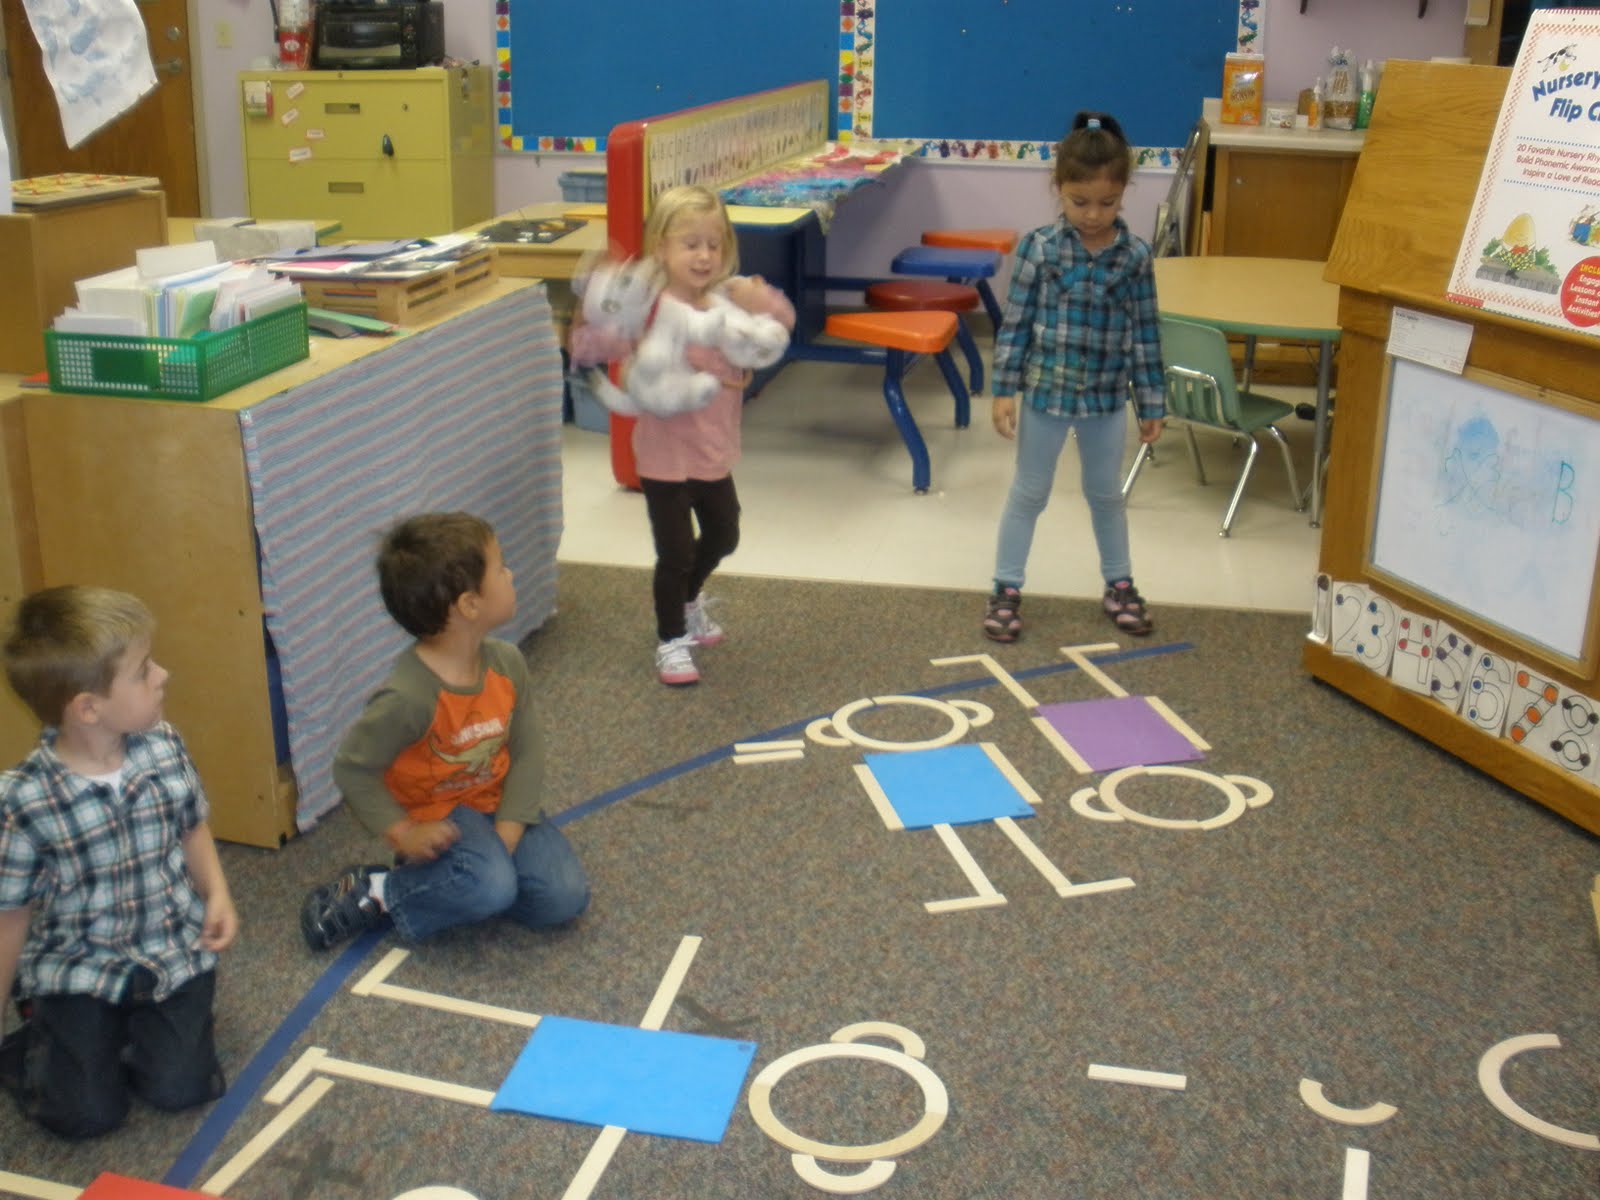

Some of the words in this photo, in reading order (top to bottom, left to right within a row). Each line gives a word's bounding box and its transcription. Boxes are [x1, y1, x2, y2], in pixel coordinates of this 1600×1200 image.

[1532, 71, 1600, 101] Nursery
[1550, 97, 1583, 122] Flip
[1517, 144, 1527, 152] 20
[1528, 145, 1555, 156] Favorite
[1557, 149, 1586, 161] Nursery
[1516, 155, 1533, 164] Build
[1535, 157, 1569, 169] Phonemic
[1523, 168, 1546, 178] Inspire
[1554, 172, 1571, 182] Love
[1572, 175, 1582, 183] of
[1570, 283, 1596, 295] Lessons
[1575, 294, 1599, 307] Instant
[1552, 461, 1575, 525] B
[1335, 584, 1367, 654] 2
[1356, 597, 1395, 670] 3
[1397, 617, 1435, 686] 4
[1431, 632, 1473, 700] 5
[1467, 653, 1511, 730] 6
[1511, 670, 1560, 744] 7
[1550, 694, 1600, 772] 8
